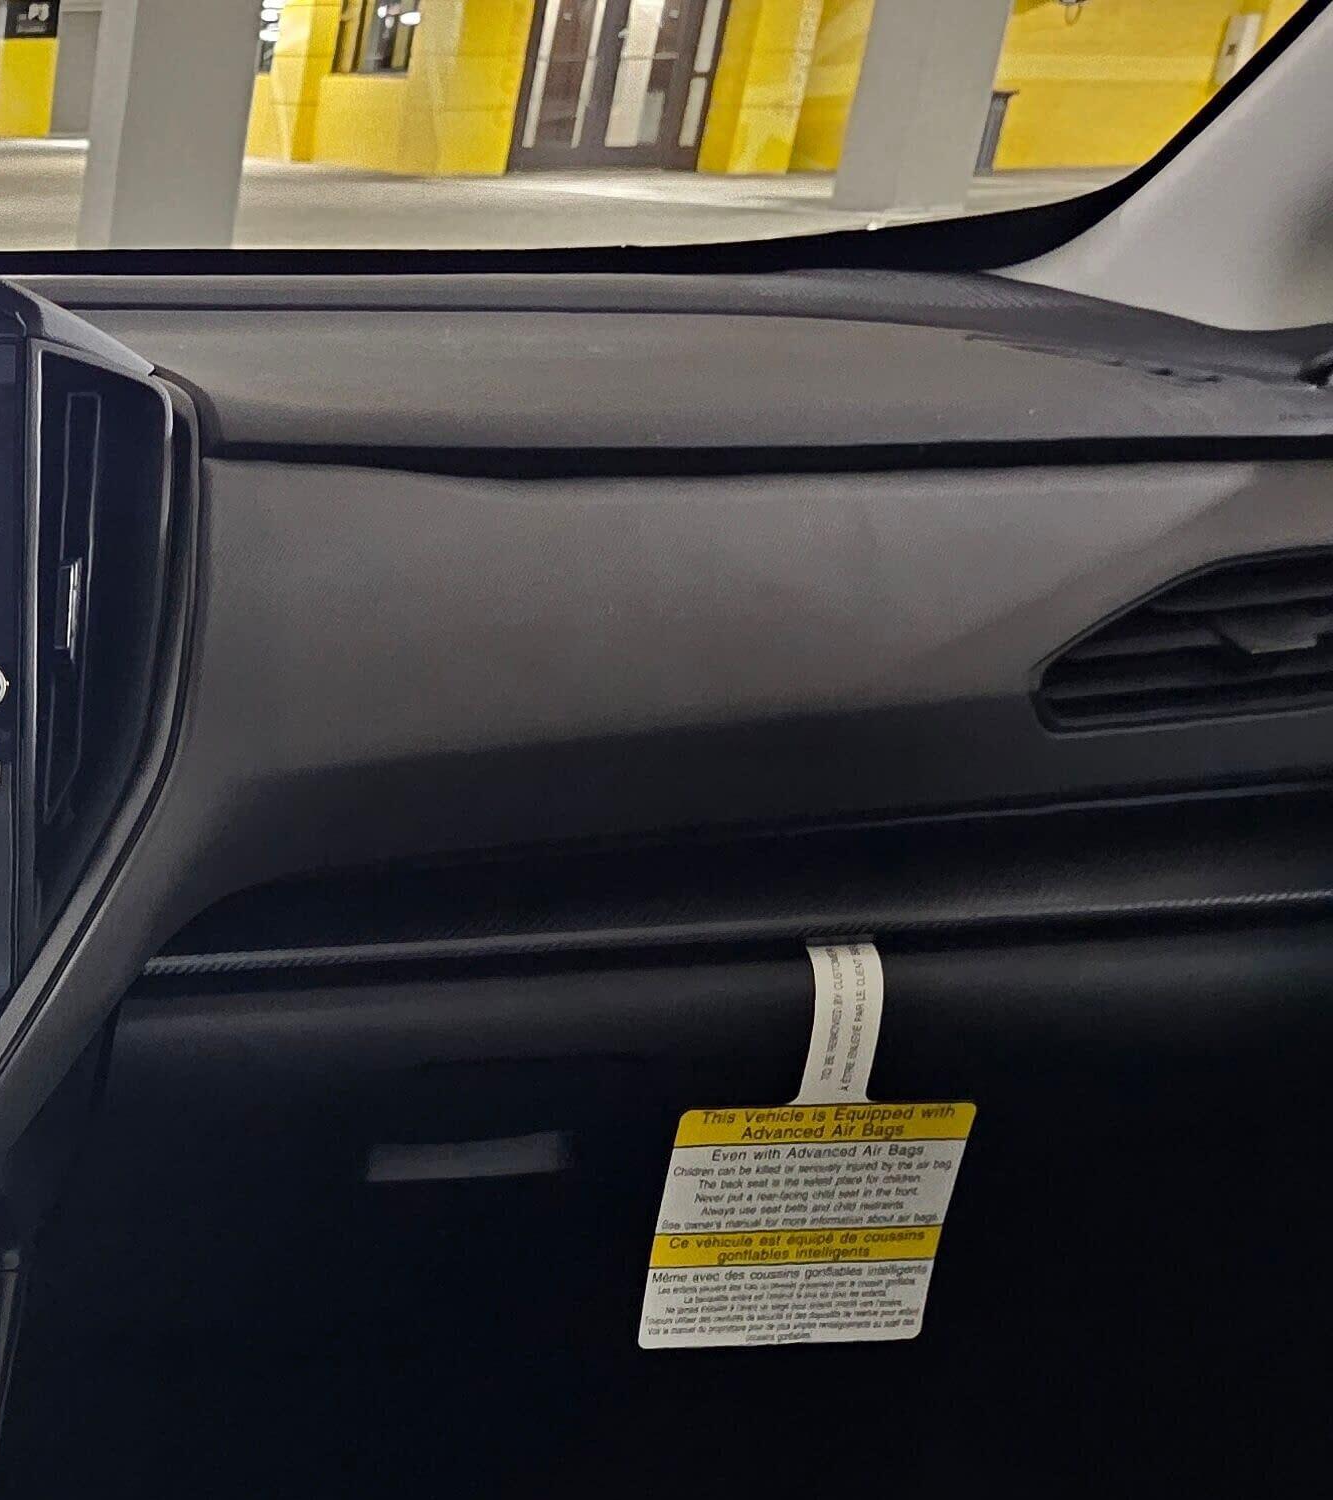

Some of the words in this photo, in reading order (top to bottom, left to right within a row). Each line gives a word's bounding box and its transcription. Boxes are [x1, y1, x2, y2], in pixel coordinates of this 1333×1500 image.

[702, 1111, 735, 1125] This
[745, 1109, 804, 1123] Vehicle
[812, 1108, 826, 1122] is
[834, 1105, 914, 1122] Equipped
[922, 1104, 955, 1118] with
[741, 1125, 824, 1140] Advanced
[832, 1124, 855, 1137] Air
[862, 1123, 904, 1139] Bags
[712, 1149, 746, 1162] Even
[753, 1148, 781, 1160] with
[786, 1146, 856, 1159] Advanced
[863, 1145, 881, 1157] Air
[888, 1144, 925, 1158] Bags
[674, 1166, 714, 1177] Children
[717, 1167, 735, 1177] can
[739, 1165, 751, 1175] be
[699, 1180, 716, 1189] The
[701, 1206, 735, 1217] Always
[670, 1237, 689, 1249] Ce
[759, 1234, 781, 1247] est
[840, 1233, 857, 1244] de
[864, 1230, 925, 1243] coussins
[717, 1251, 789, 1264] gonflables
[796, 1246, 870, 1260] intelligents
[693, 1272, 720, 1282] avec
[724, 1270, 744, 1281] des
